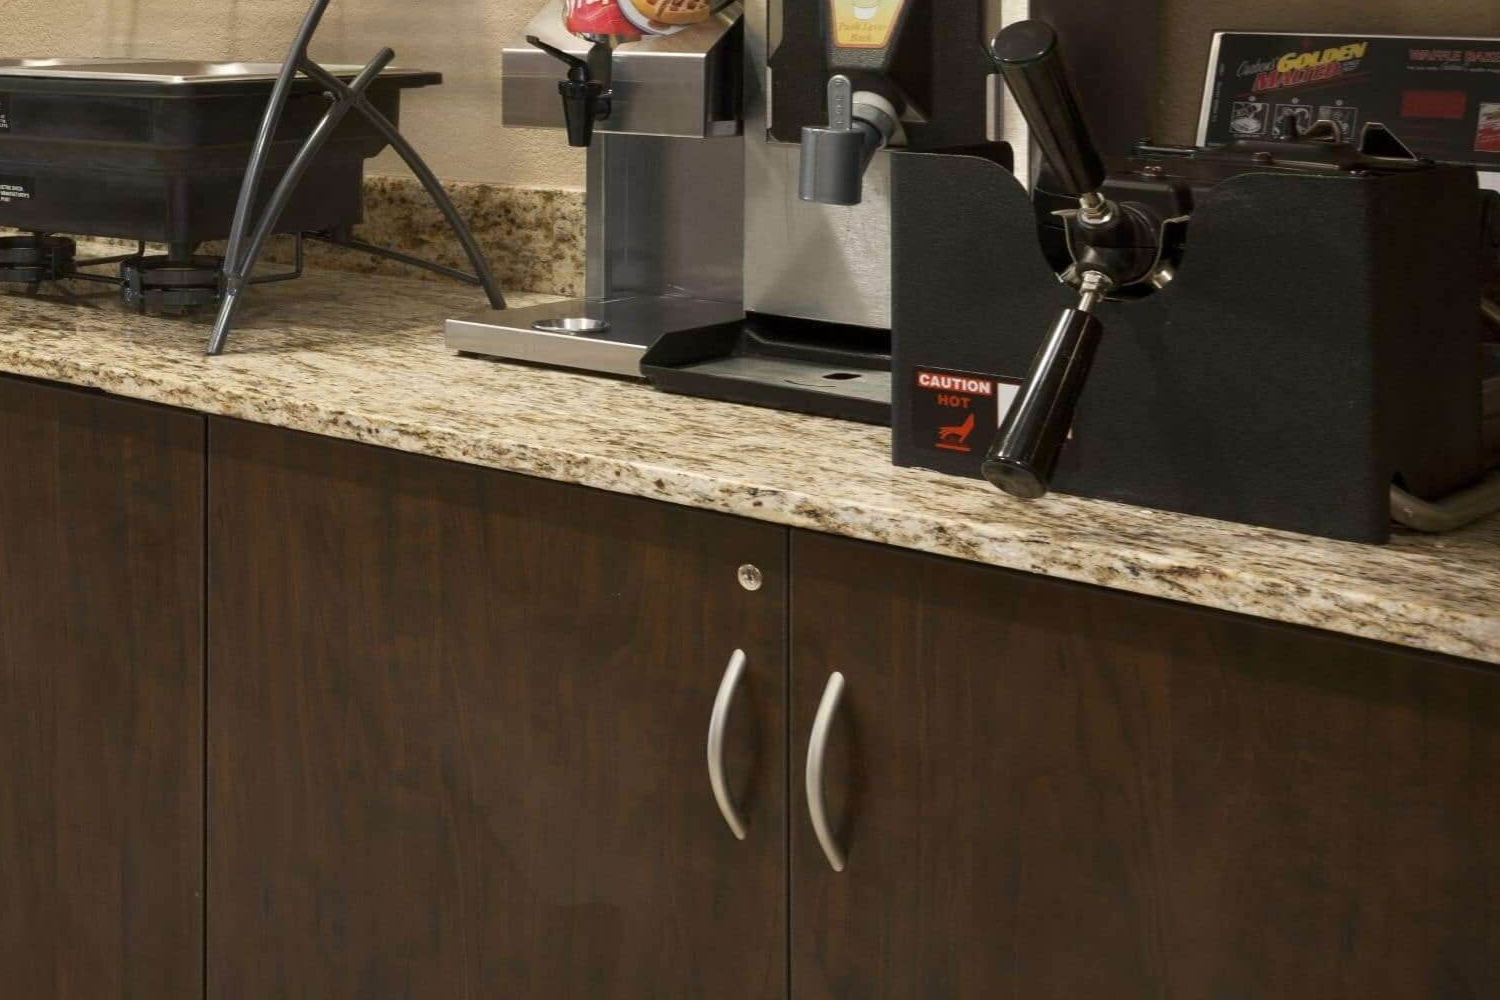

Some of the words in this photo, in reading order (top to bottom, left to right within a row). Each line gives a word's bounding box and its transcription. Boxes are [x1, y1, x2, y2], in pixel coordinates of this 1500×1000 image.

[1277, 41, 1369, 73] GOLDEN
[918, 374, 992, 394] CAUTION
[937, 395, 972, 408] HOT
